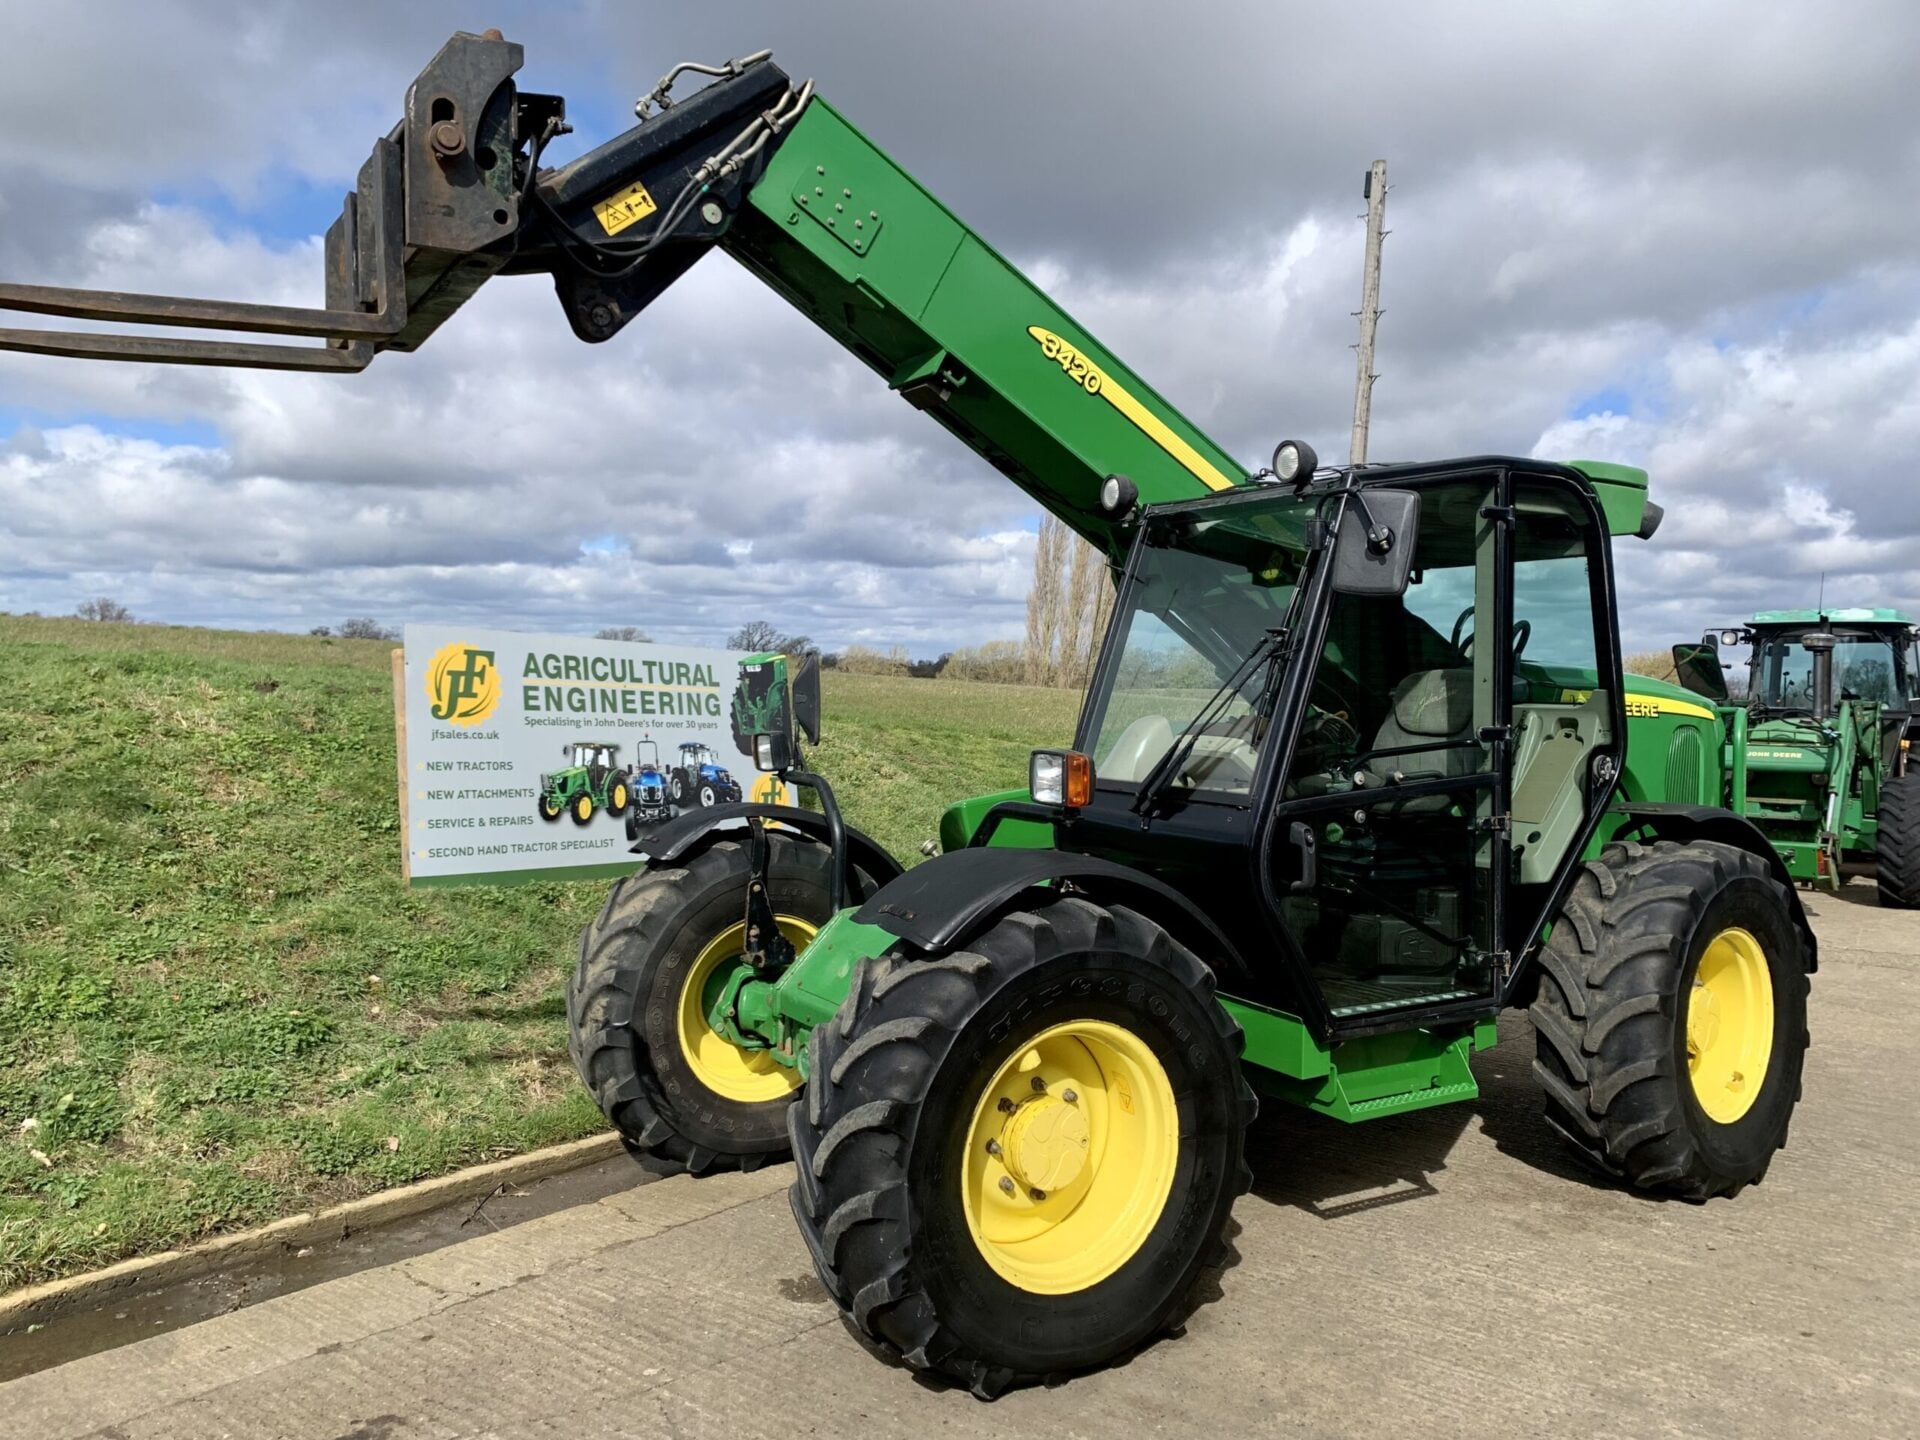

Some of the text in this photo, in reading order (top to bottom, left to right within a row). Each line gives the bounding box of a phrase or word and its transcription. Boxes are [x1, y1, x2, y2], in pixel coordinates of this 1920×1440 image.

[1041, 334, 1102, 395] 3420
[522, 652, 721, 688] AGRICULTURAL
[522, 685, 721, 717] ENGINEERING
[1625, 702, 1659, 718] EERE
[524, 716, 582, 729] Specialising
[583, 717, 592, 726] in
[594, 717, 616, 727] John
[617, 718, 650, 728] Deere's
[651, 719, 664, 728] for
[685, 720, 696, 728] 30
[697, 721, 718, 731] years
[431, 729, 500, 741] jfsales.co.uk
[426, 761, 514, 772] NEW TRACTORS
[427, 788, 535, 800] NEW ATTACHMENTS
[427, 816, 534, 829] SERVICE & REPAIRS
[428, 838, 615, 859] SECOND HAND TRACTOR SPECIALIST
